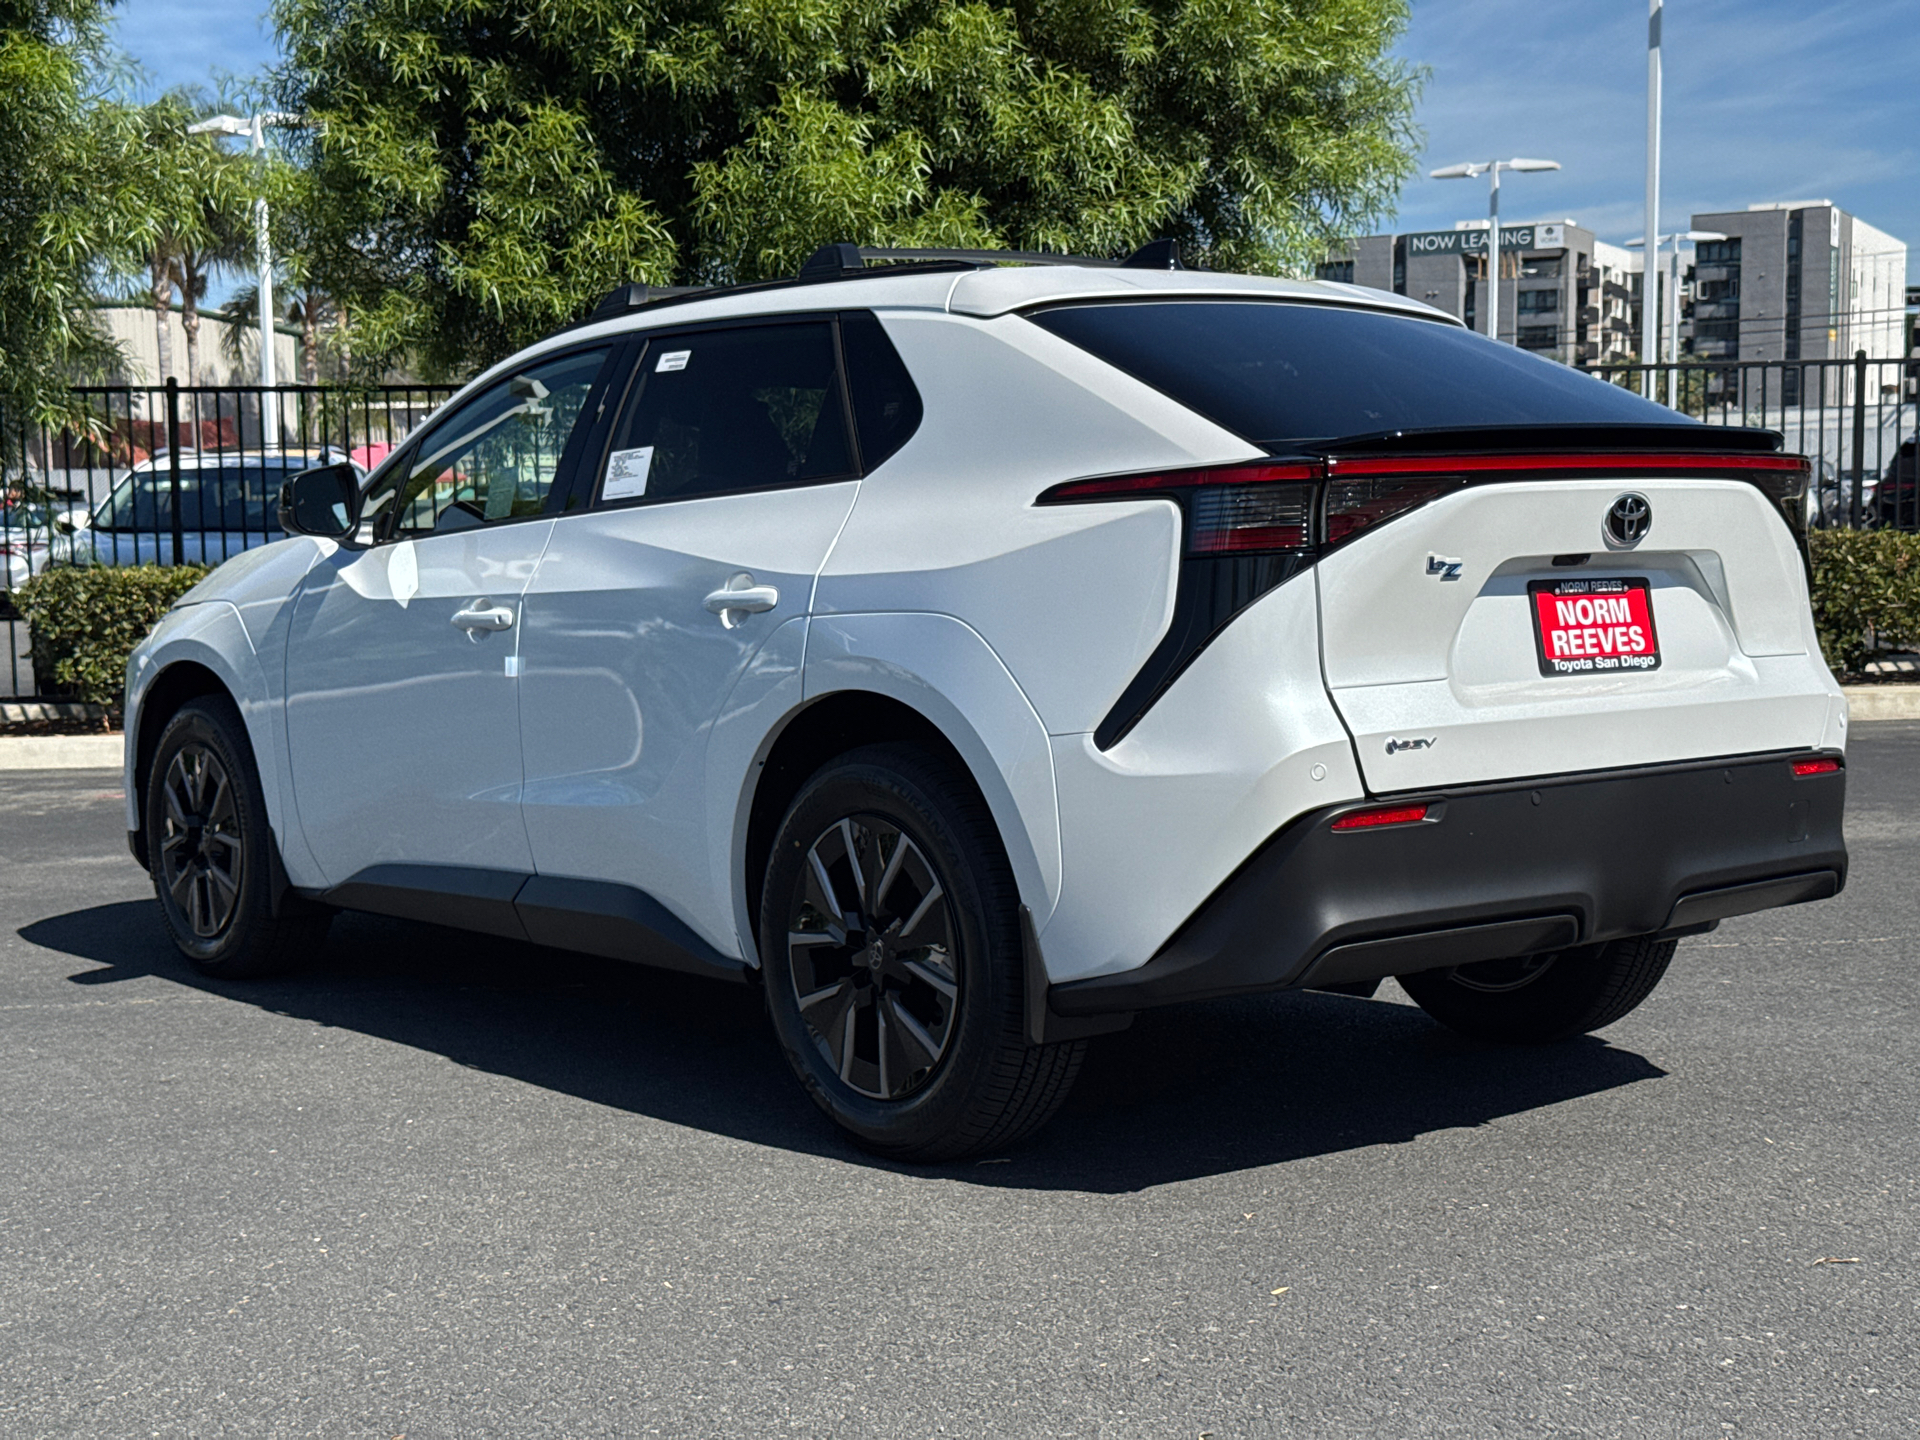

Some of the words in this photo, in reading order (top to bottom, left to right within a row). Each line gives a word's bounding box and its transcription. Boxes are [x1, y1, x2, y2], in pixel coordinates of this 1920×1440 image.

[1412, 235, 1456, 251] NOW
[1461, 229, 1532, 248] LEAING
[1560, 581, 1589, 593] NORM
[1591, 580, 1622, 592] REEVES
[1555, 597, 1632, 627] NORM
[1551, 625, 1646, 656] REEVES
[1552, 658, 1593, 673] Toyota
[1595, 656, 1619, 669] San
[1620, 655, 1656, 668] Diego
